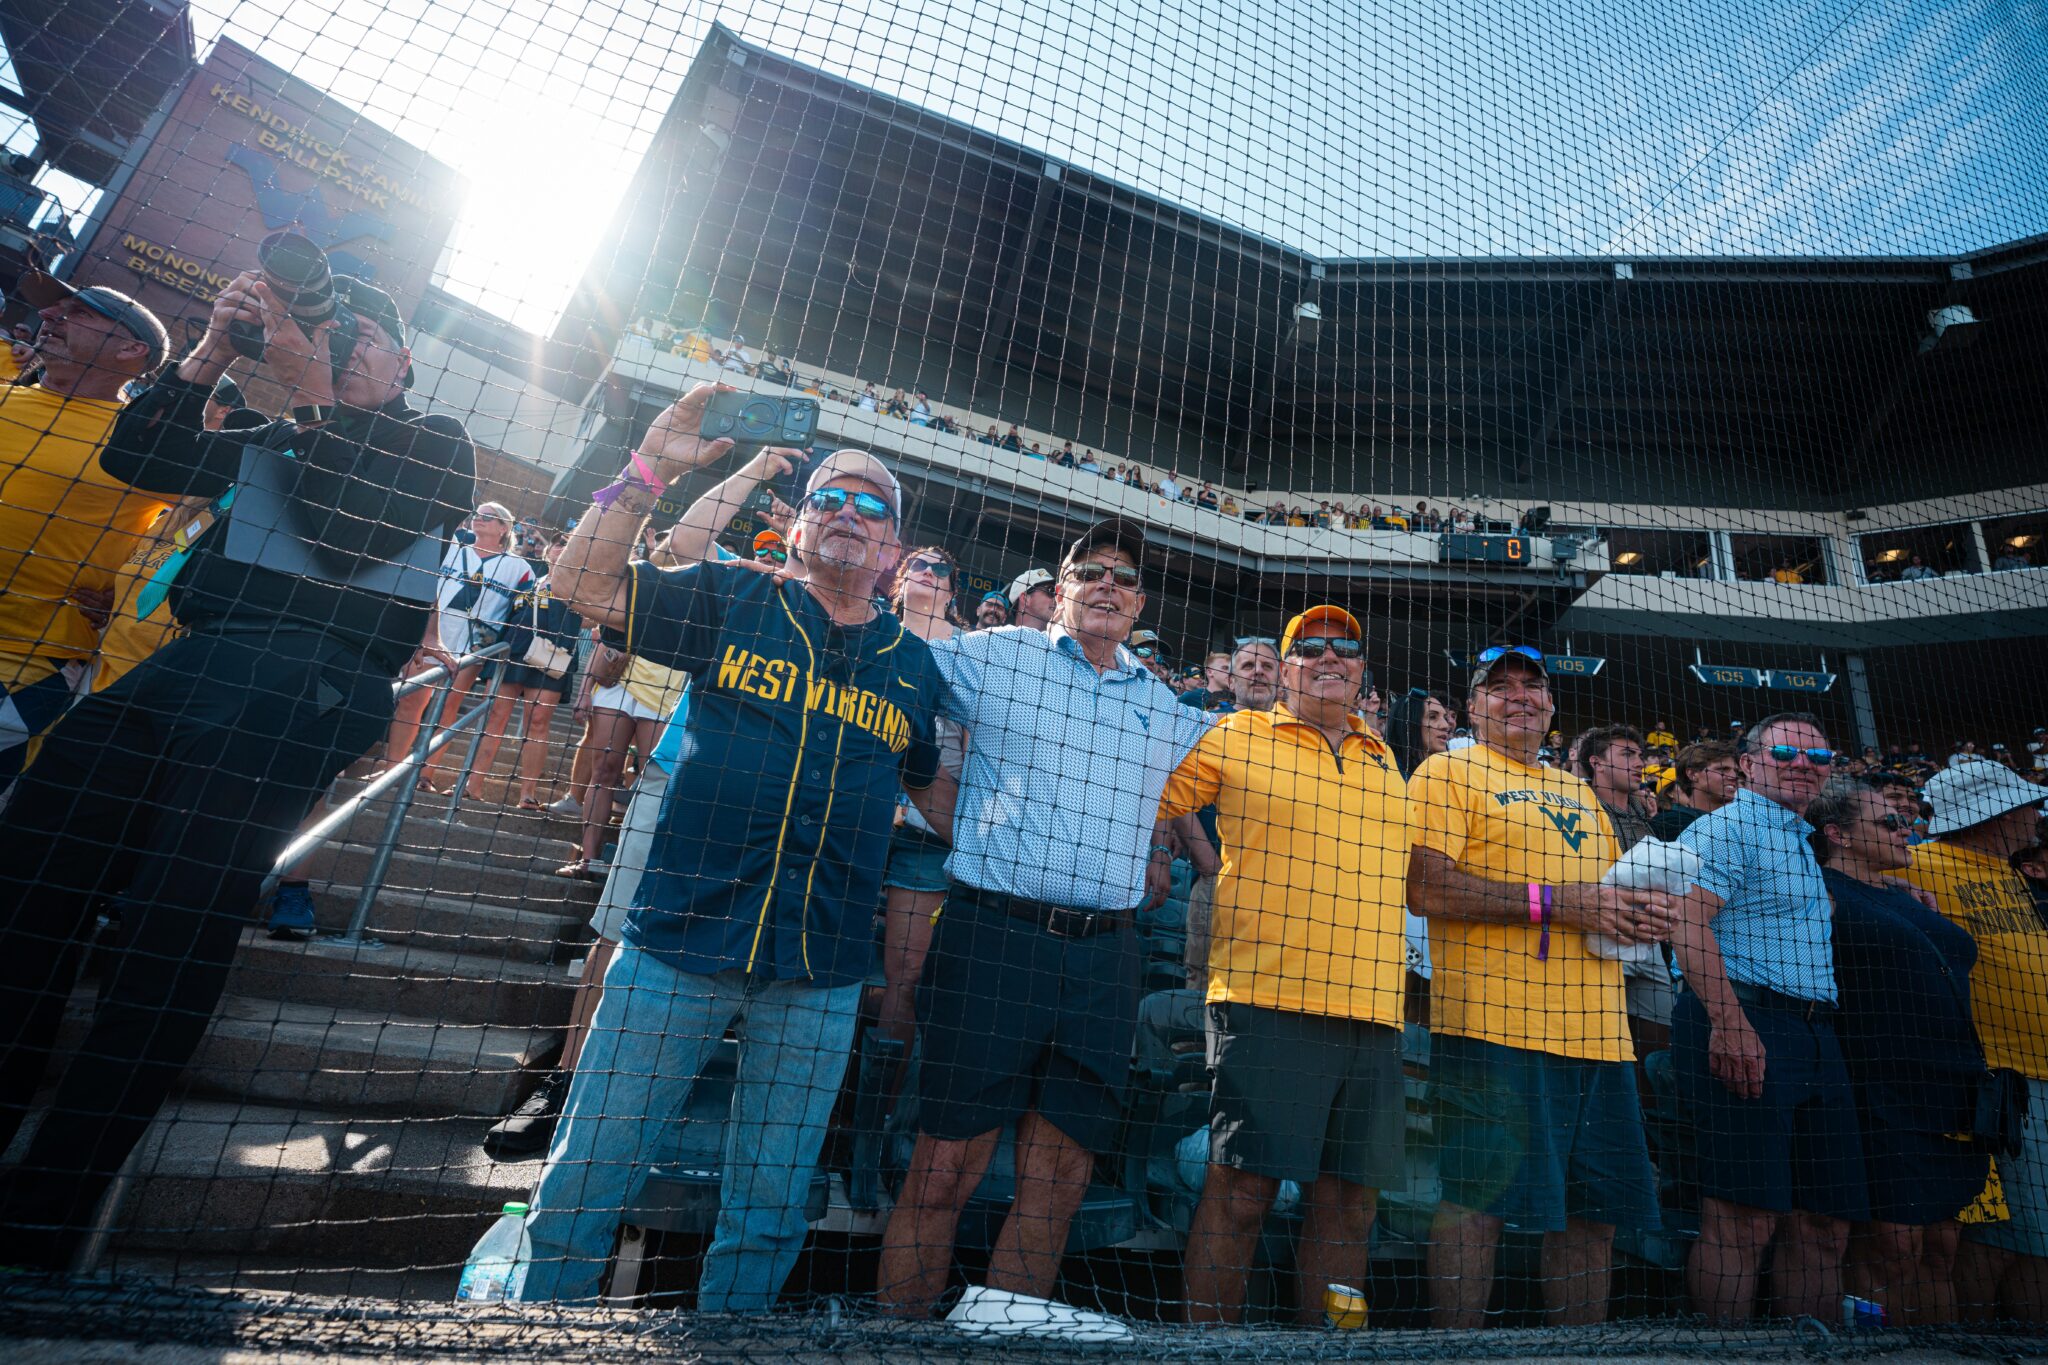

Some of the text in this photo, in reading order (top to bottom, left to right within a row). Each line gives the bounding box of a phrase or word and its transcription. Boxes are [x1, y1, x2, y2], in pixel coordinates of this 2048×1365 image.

[210, 82, 351, 170] KENDRICK
[258, 129, 389, 210] BALLPARK
[1508, 539, 1521, 559] 0
[968, 575, 992, 592] 106
[717, 644, 800, 703] WEST
[1555, 659, 1586, 672] 105
[1713, 670, 1745, 683] 105
[1785, 675, 1817, 688] 104
[1494, 788, 1539, 807] WEST
[1952, 881, 2003, 910] WEST
